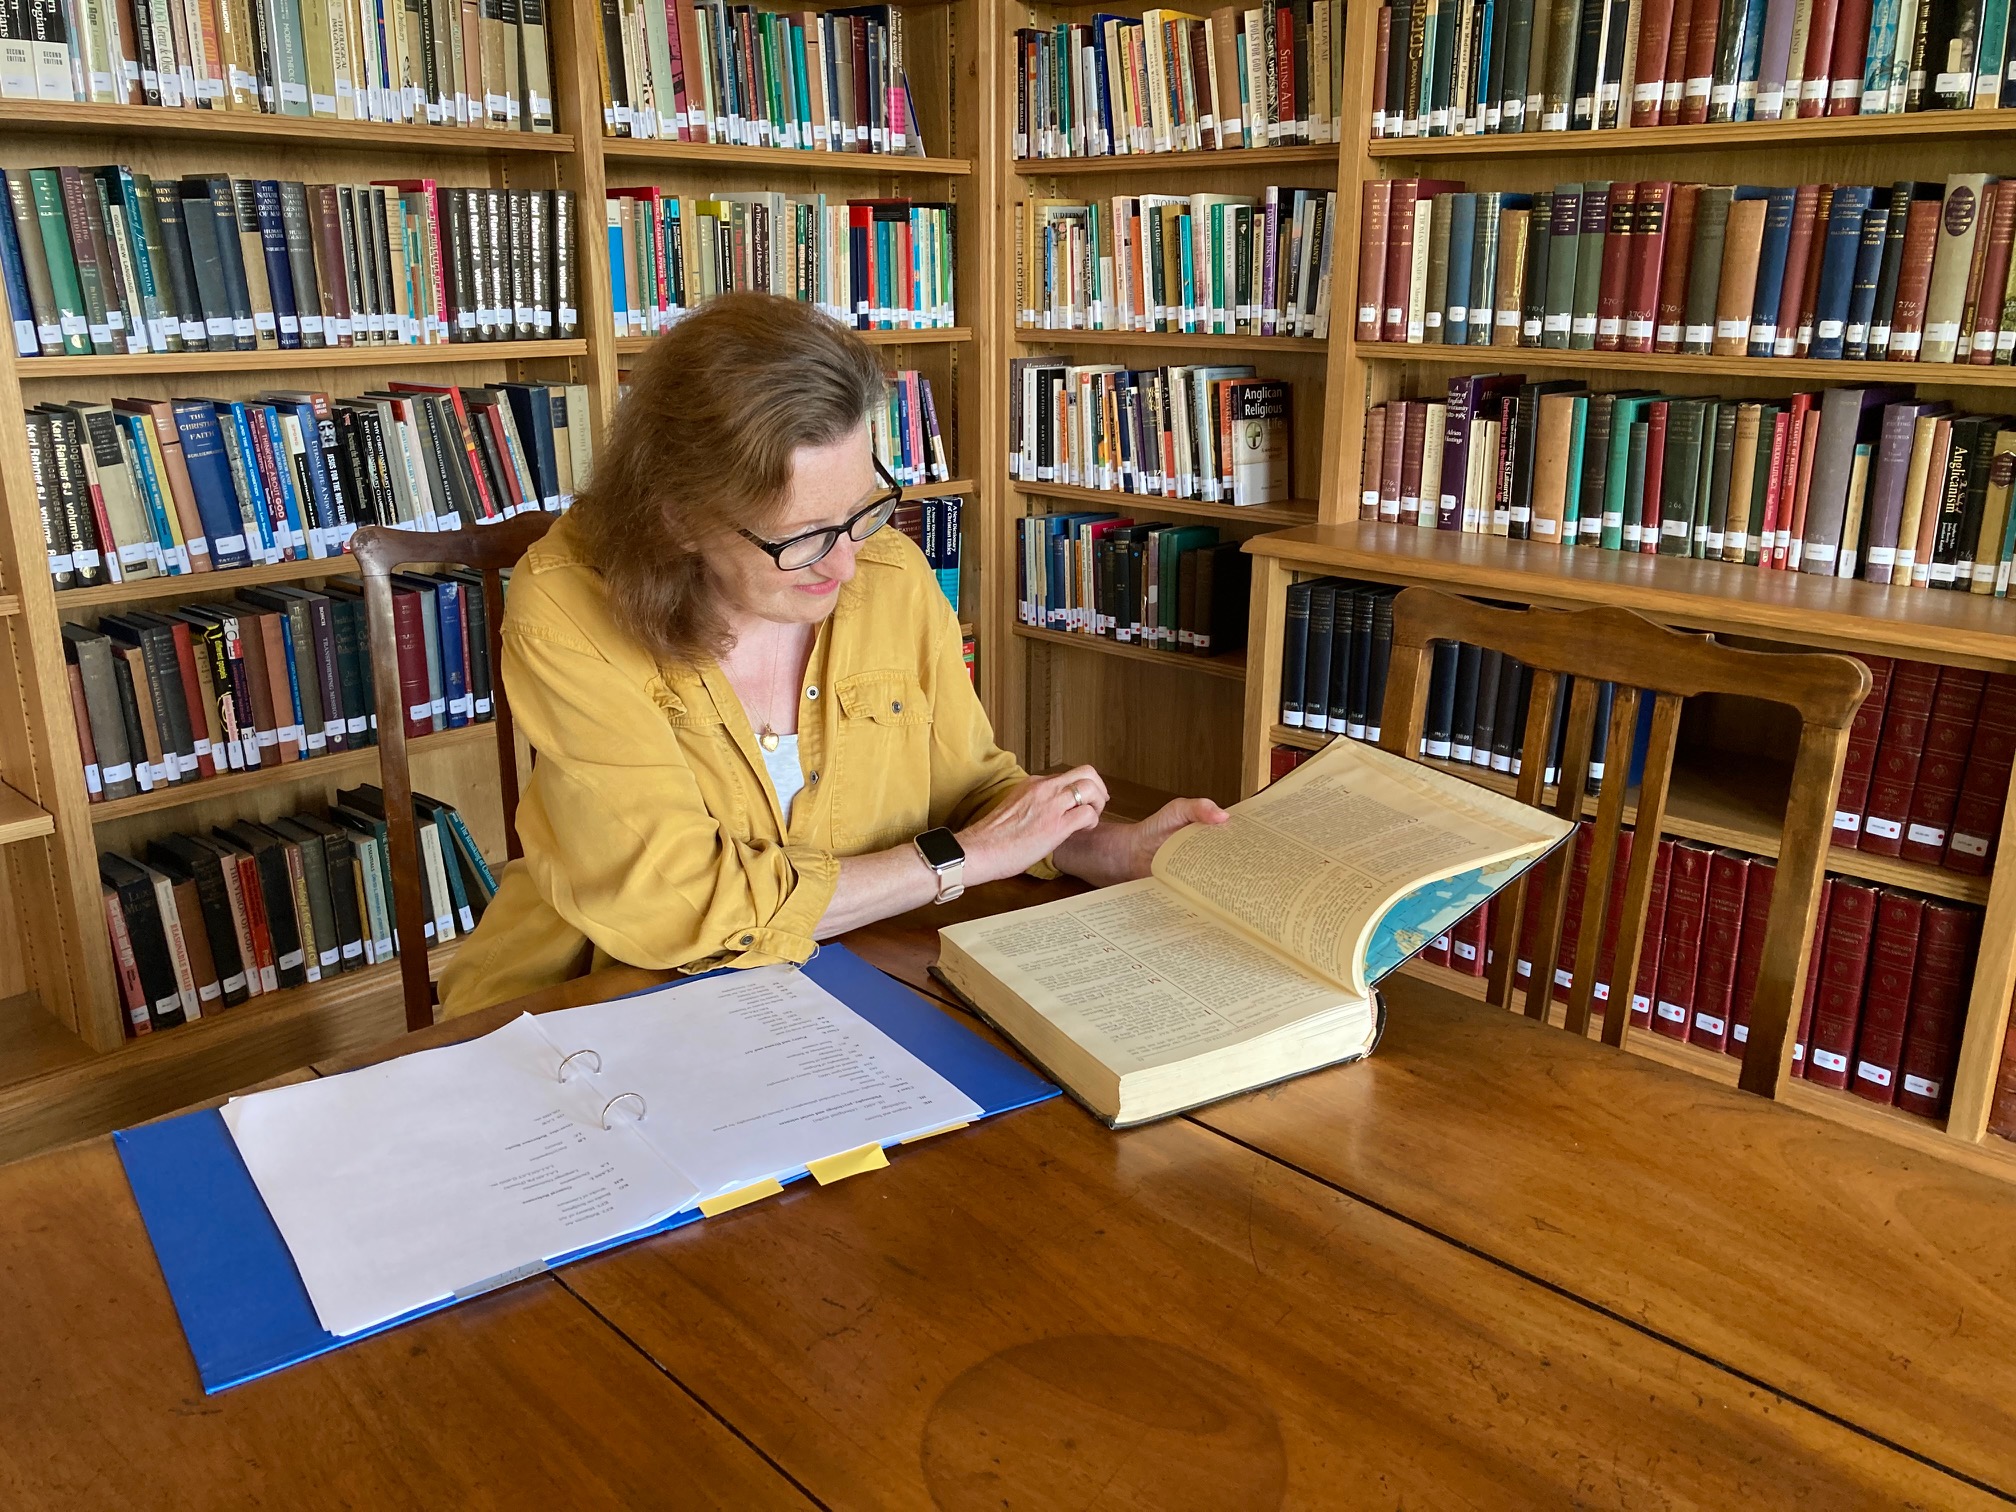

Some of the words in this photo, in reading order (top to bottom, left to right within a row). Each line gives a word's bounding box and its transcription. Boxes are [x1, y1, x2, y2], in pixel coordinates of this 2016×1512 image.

[282, 22, 292, 53] MODERN
[330, 18, 341, 70] IMAGINATION
[336, 20, 347, 68] THEOLOGICAL
[1249, 19, 1259, 41] FOOLS
[1251, 44, 1260, 55] FOR
[1252, 58, 1261, 72] GOD
[1280, 49, 1290, 88] SELLING
[1459, 65, 1467, 89] Papacy
[1281, 91, 1291, 111] ALL
[489, 194, 498, 214] Karl
[511, 195, 519, 215] Karl
[531, 196, 540, 216] Karl
[558, 196, 566, 215] Karl
[490, 216, 499, 248] Rahner
[511, 217, 520, 248] Rahner
[531, 218, 540, 250] Rahner
[558, 217, 567, 248] Rahner
[753, 213, 762, 243] Theology
[1314, 207, 1322, 236] WOMEN
[1311, 238, 1320, 264] SAINTS
[122, 260, 134, 293] LANGUAGE
[755, 252, 764, 283] Liberation
[1016, 268, 1023, 277] of
[514, 268, 523, 300] volume
[559, 266, 567, 298] volume
[1015, 279, 1024, 313] prayer
[1244, 387, 1282, 402] Anglican
[189, 413, 205, 421] THE
[1245, 404, 1282, 418] Religious
[1267, 419, 1282, 429] Life
[26, 423, 38, 443] Karl
[51, 420, 62, 442] Karl
[189, 431, 215, 440] FAITH
[1776, 422, 1784, 432] THE
[30, 444, 43, 483] Rahner
[55, 444, 68, 481] Rahner
[311, 440, 322, 468] ETERNAL
[261, 434, 274, 469] THINKING
[268, 471, 280, 495] ABOUT
[274, 497, 285, 518] GOD
[330, 469, 339, 480] FOR
[332, 481, 341, 491] THE
[1942, 445, 1968, 514] Anglicanism
[66, 502, 79, 539] volume
[213, 640, 224, 659] different
[322, 637, 334, 689] TRANSFORMING
[329, 691, 337, 718] MISSION
[458, 824, 469, 835] The
[464, 835, 482, 861] Remaking
[480, 865, 497, 888] Christian
[228, 865, 239, 882] THE
[232, 883, 247, 916] VISION
[239, 918, 249, 930] OF
[294, 876, 308, 906] Theology
[307, 952, 320, 967] Chri
[168, 923, 187, 967] REASONABLE
[242, 931, 254, 953] GOD
